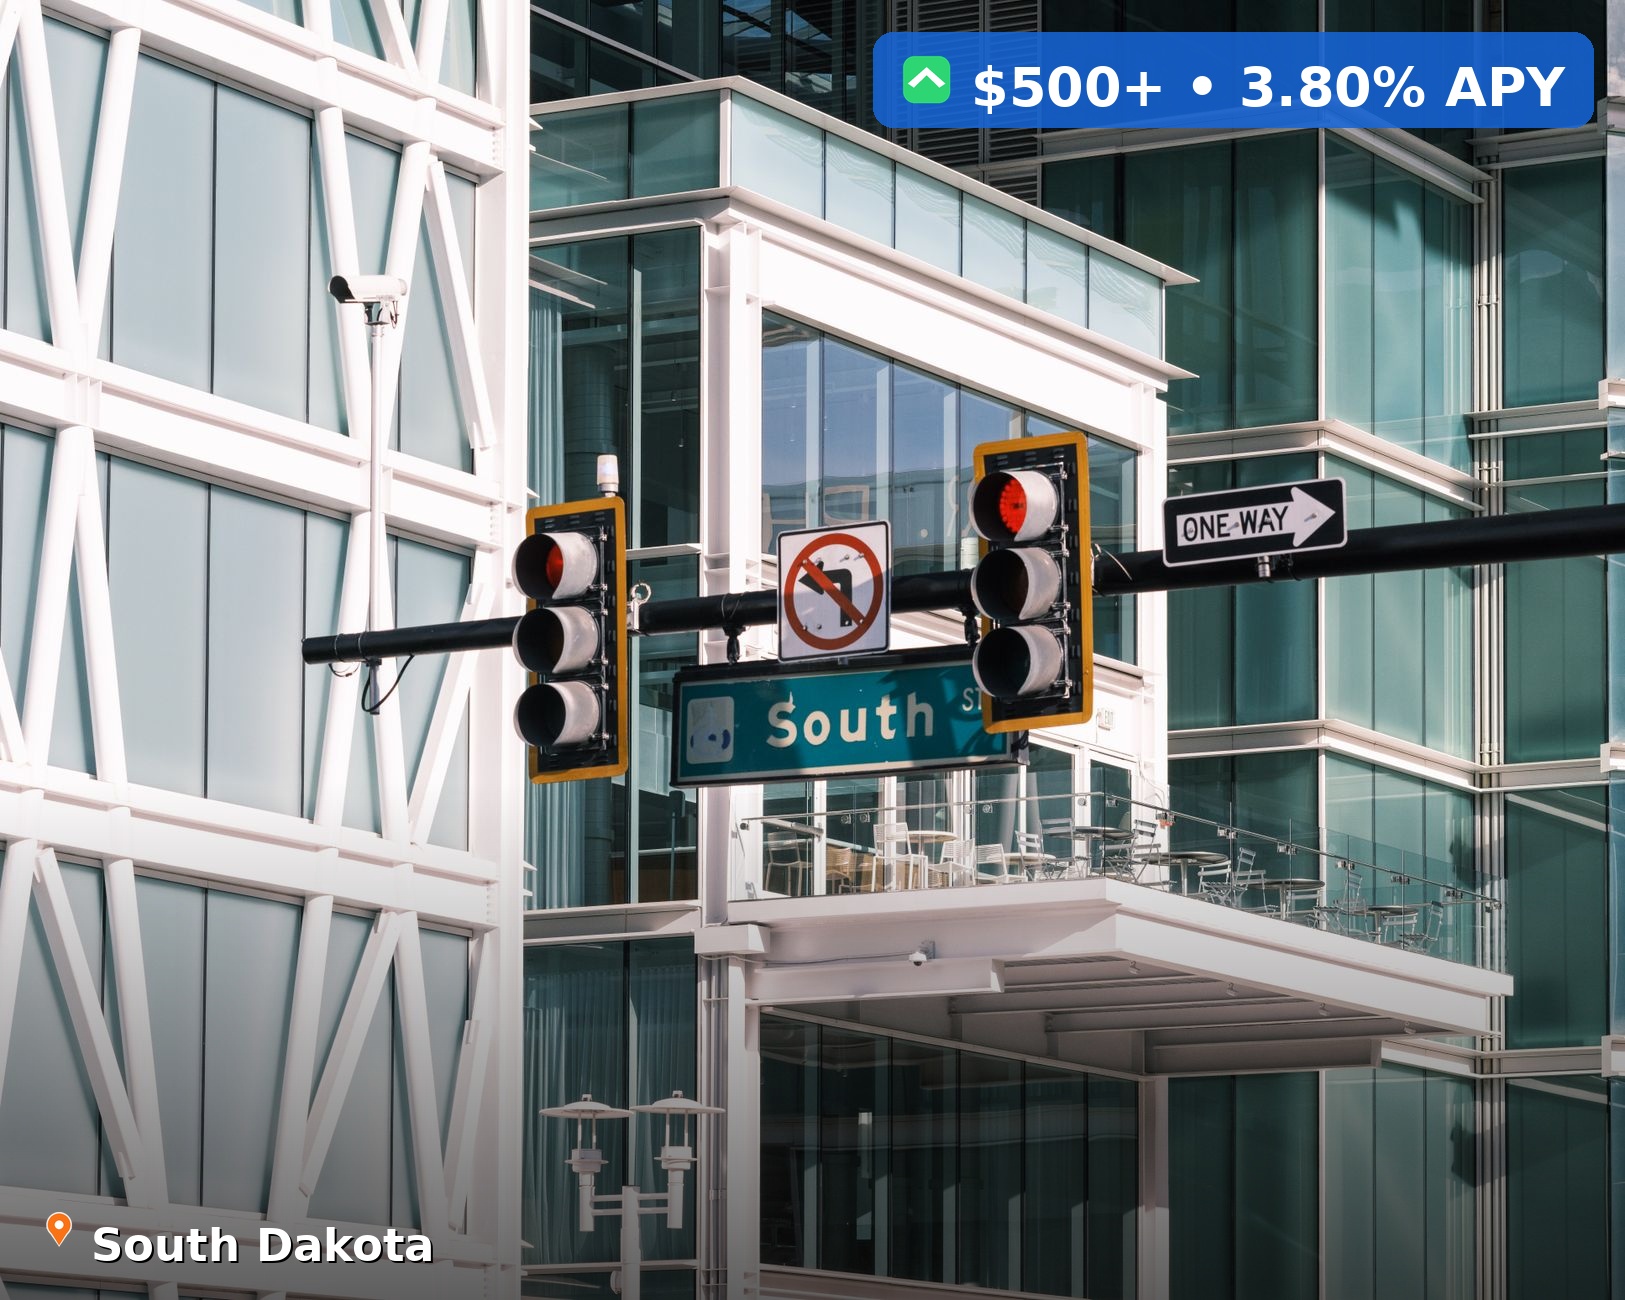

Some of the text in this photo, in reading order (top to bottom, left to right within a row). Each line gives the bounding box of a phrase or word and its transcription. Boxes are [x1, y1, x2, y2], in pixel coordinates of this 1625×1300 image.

[1183, 505, 1289, 542] ONE WAY
[766, 687, 982, 748] South ST
